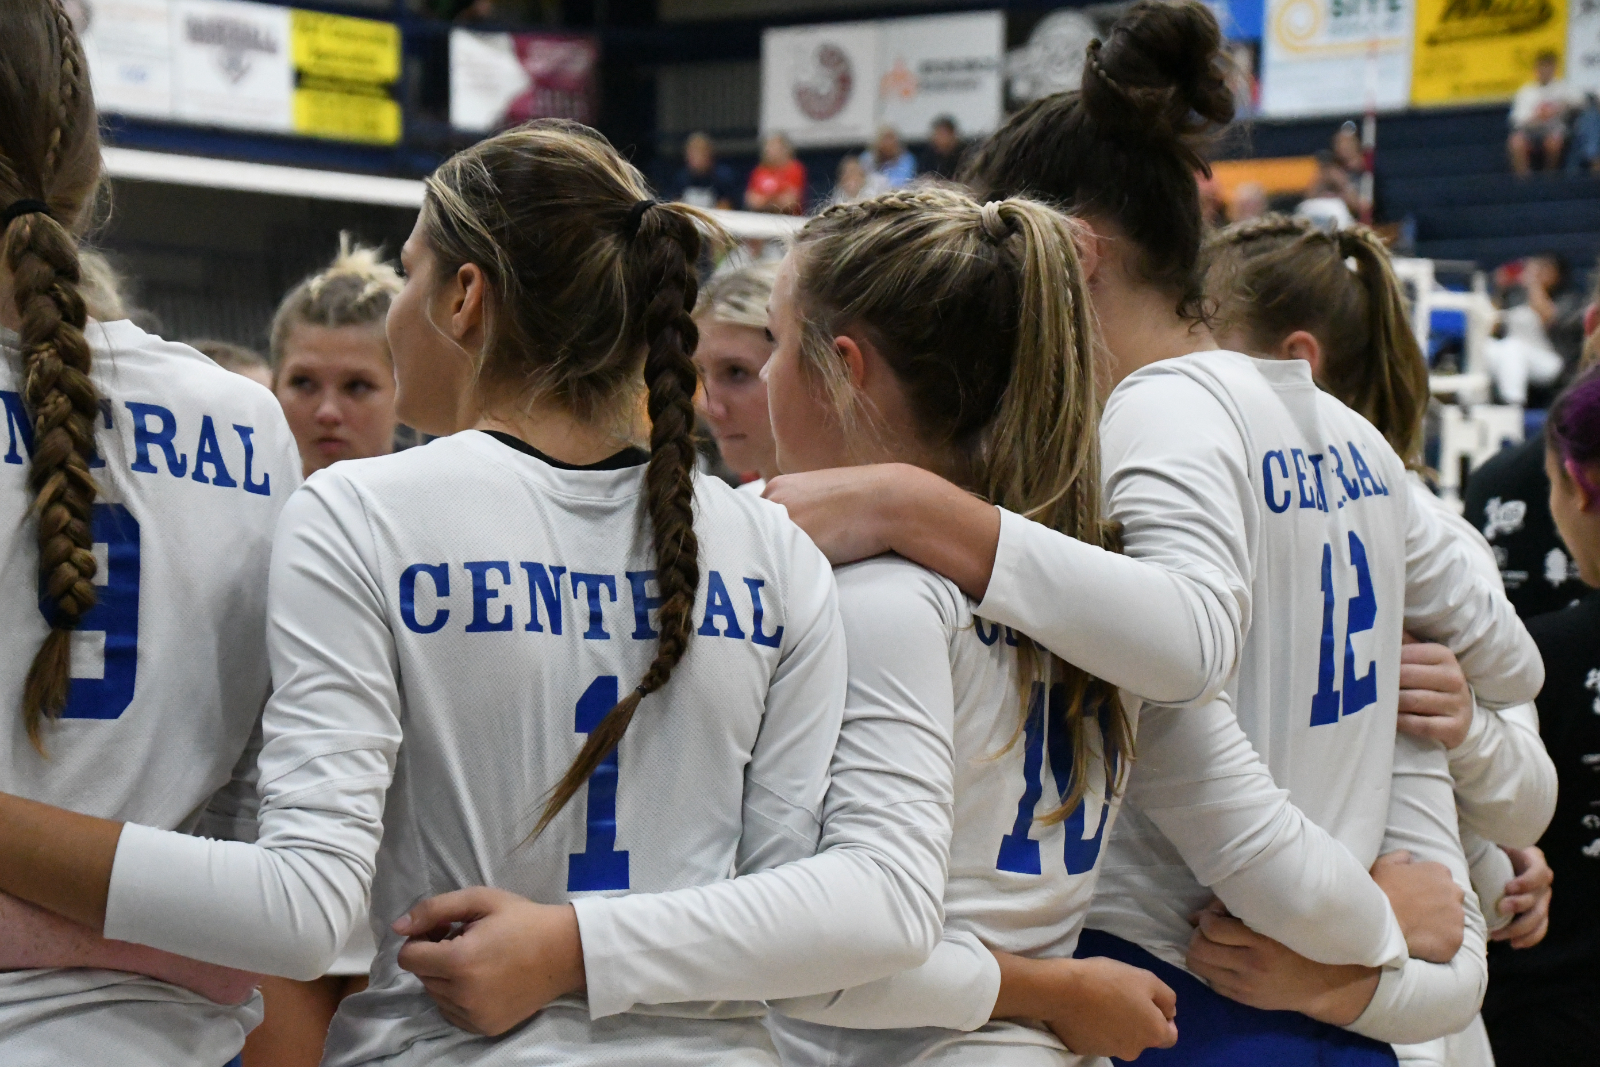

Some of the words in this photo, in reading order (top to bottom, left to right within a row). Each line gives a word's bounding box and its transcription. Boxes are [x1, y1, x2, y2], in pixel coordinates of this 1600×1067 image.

[0, 390, 270, 496] NRAL
[37, 502, 141, 720] 9
[1309, 530, 1377, 727] 12
[567, 675, 630, 892] 1
